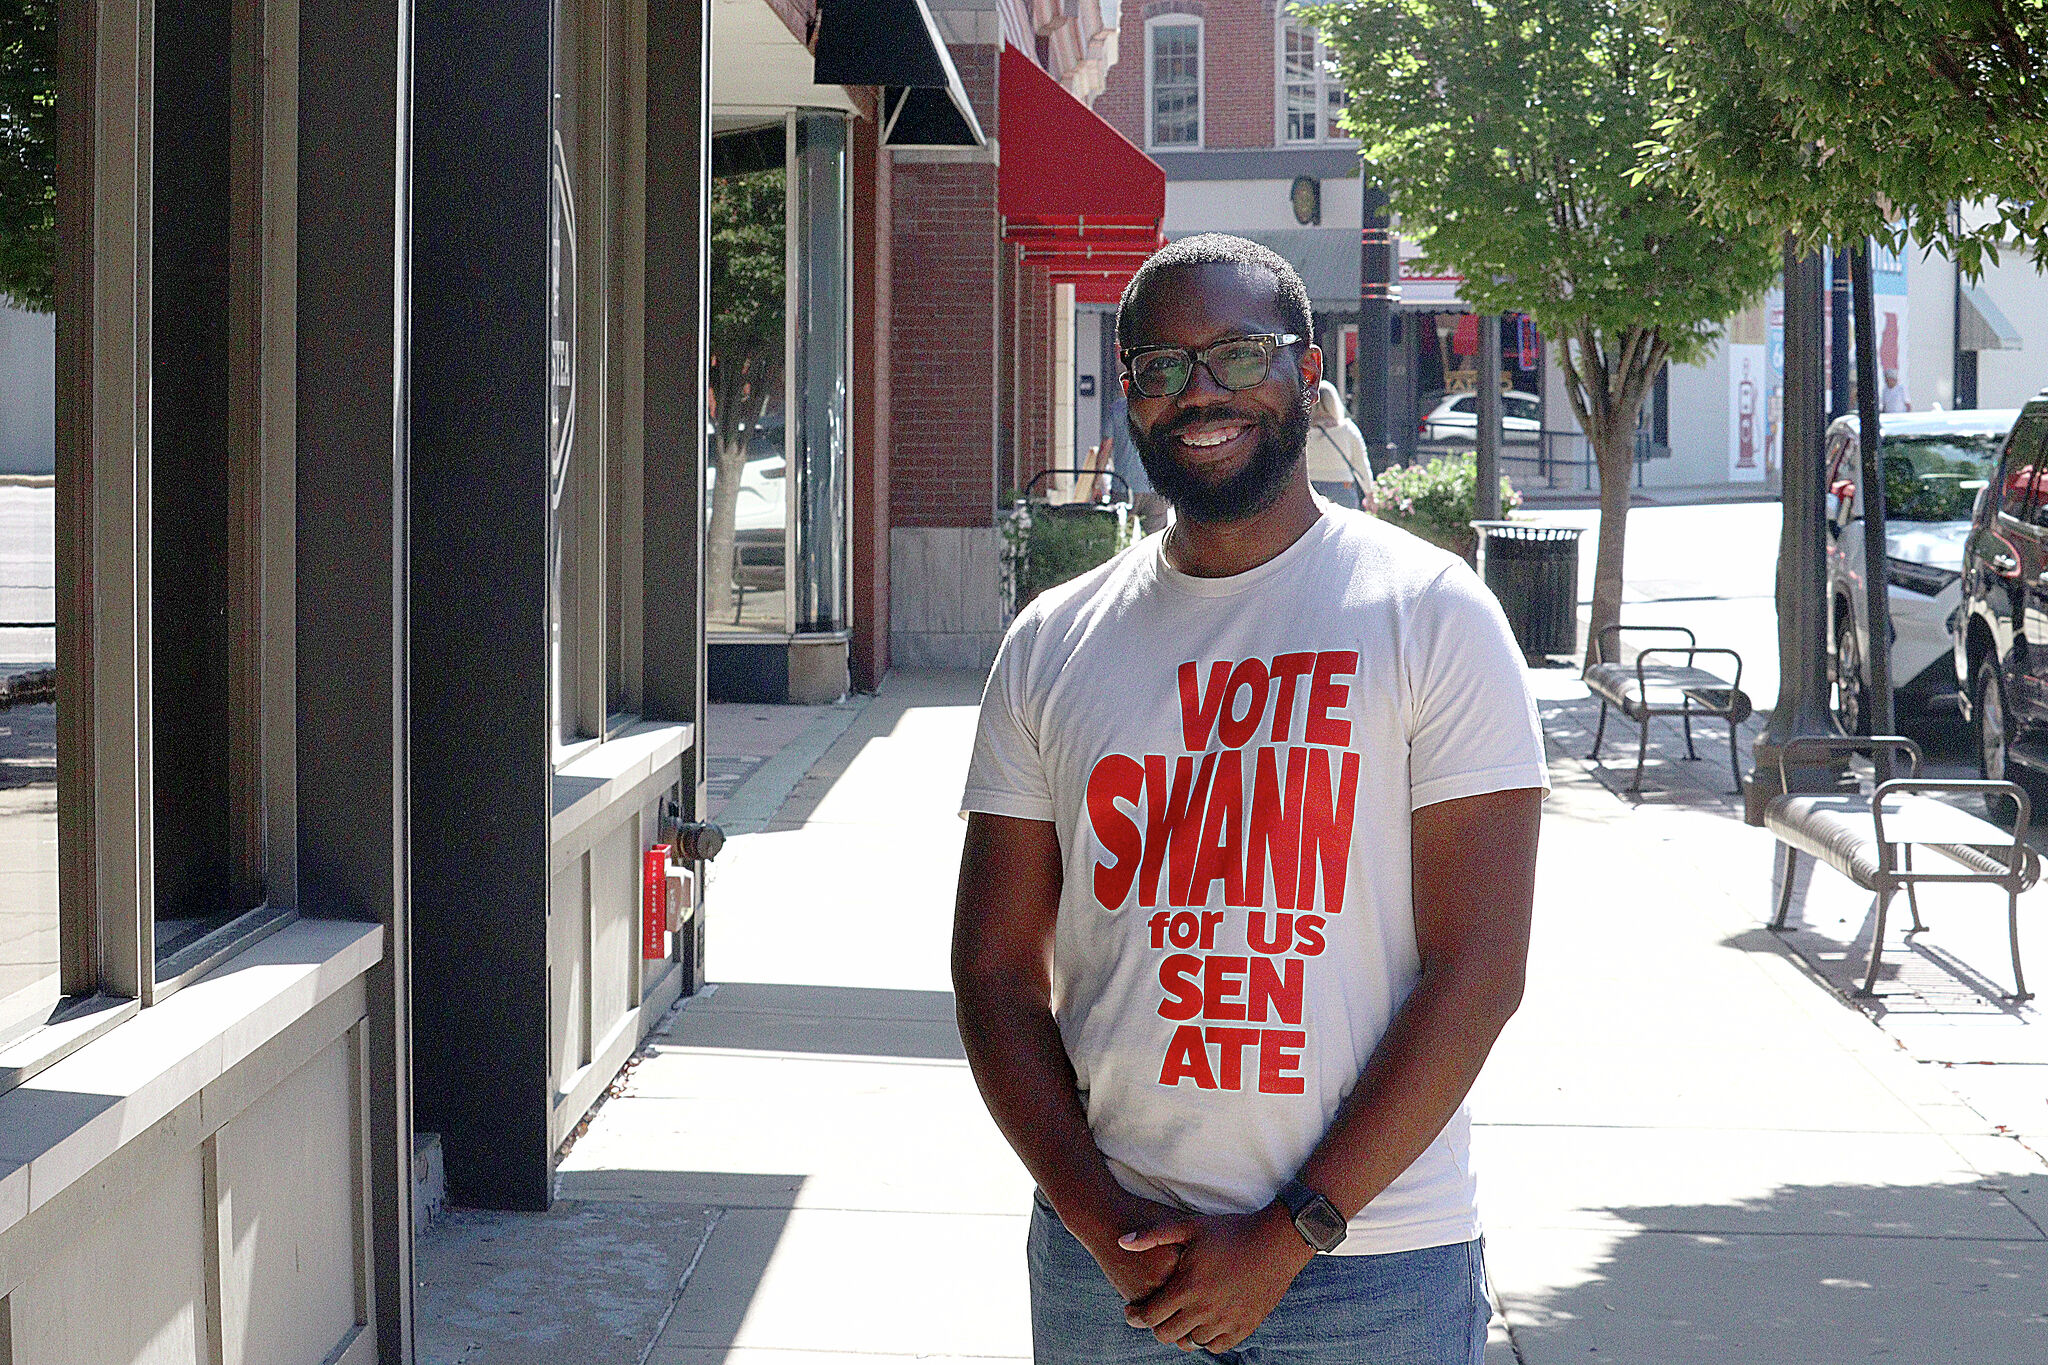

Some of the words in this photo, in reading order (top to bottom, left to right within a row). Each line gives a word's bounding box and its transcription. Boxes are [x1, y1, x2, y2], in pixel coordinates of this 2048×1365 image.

[1178, 650, 1359, 751] VOTE
[1086, 746, 1361, 914] SWANN
[1148, 911, 1224, 950] for
[1246, 911, 1327, 957] US
[1157, 954, 1305, 1025] SEN
[1159, 1025, 1307, 1095] ATE
